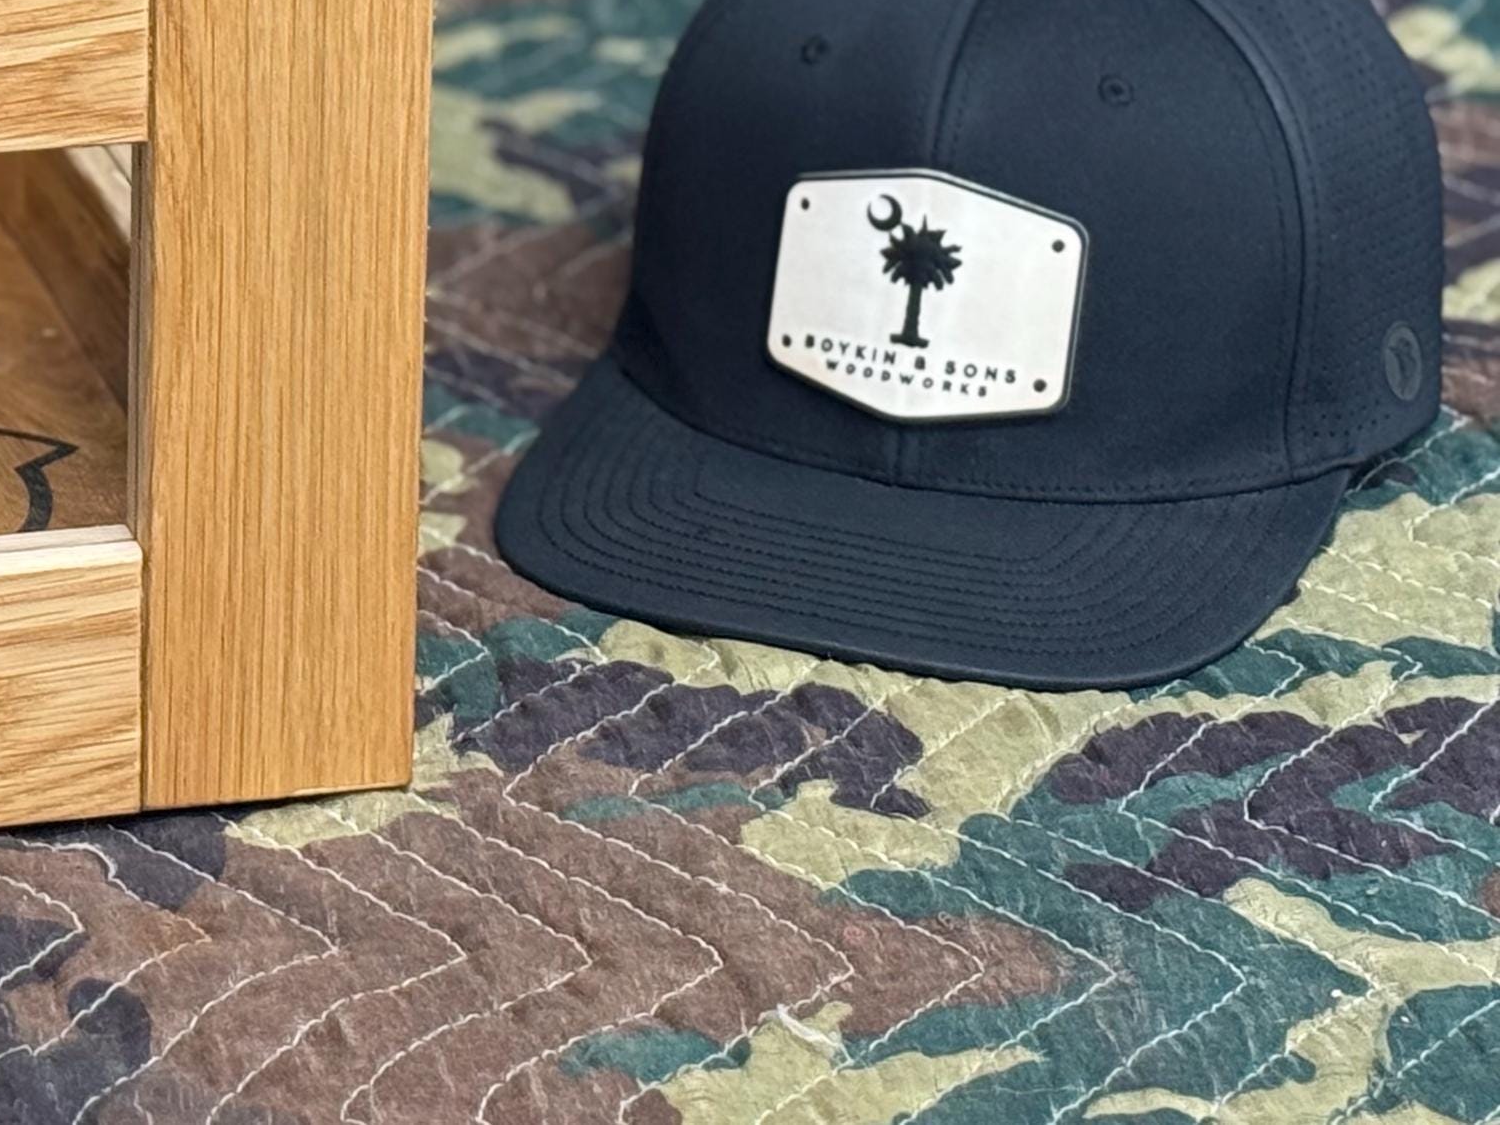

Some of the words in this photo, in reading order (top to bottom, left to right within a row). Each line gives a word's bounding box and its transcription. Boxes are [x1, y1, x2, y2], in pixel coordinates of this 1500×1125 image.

[804, 334, 897, 366] BOYKIN
[945, 359, 1017, 385] SONS
[825, 357, 989, 398] WOODWORKS
